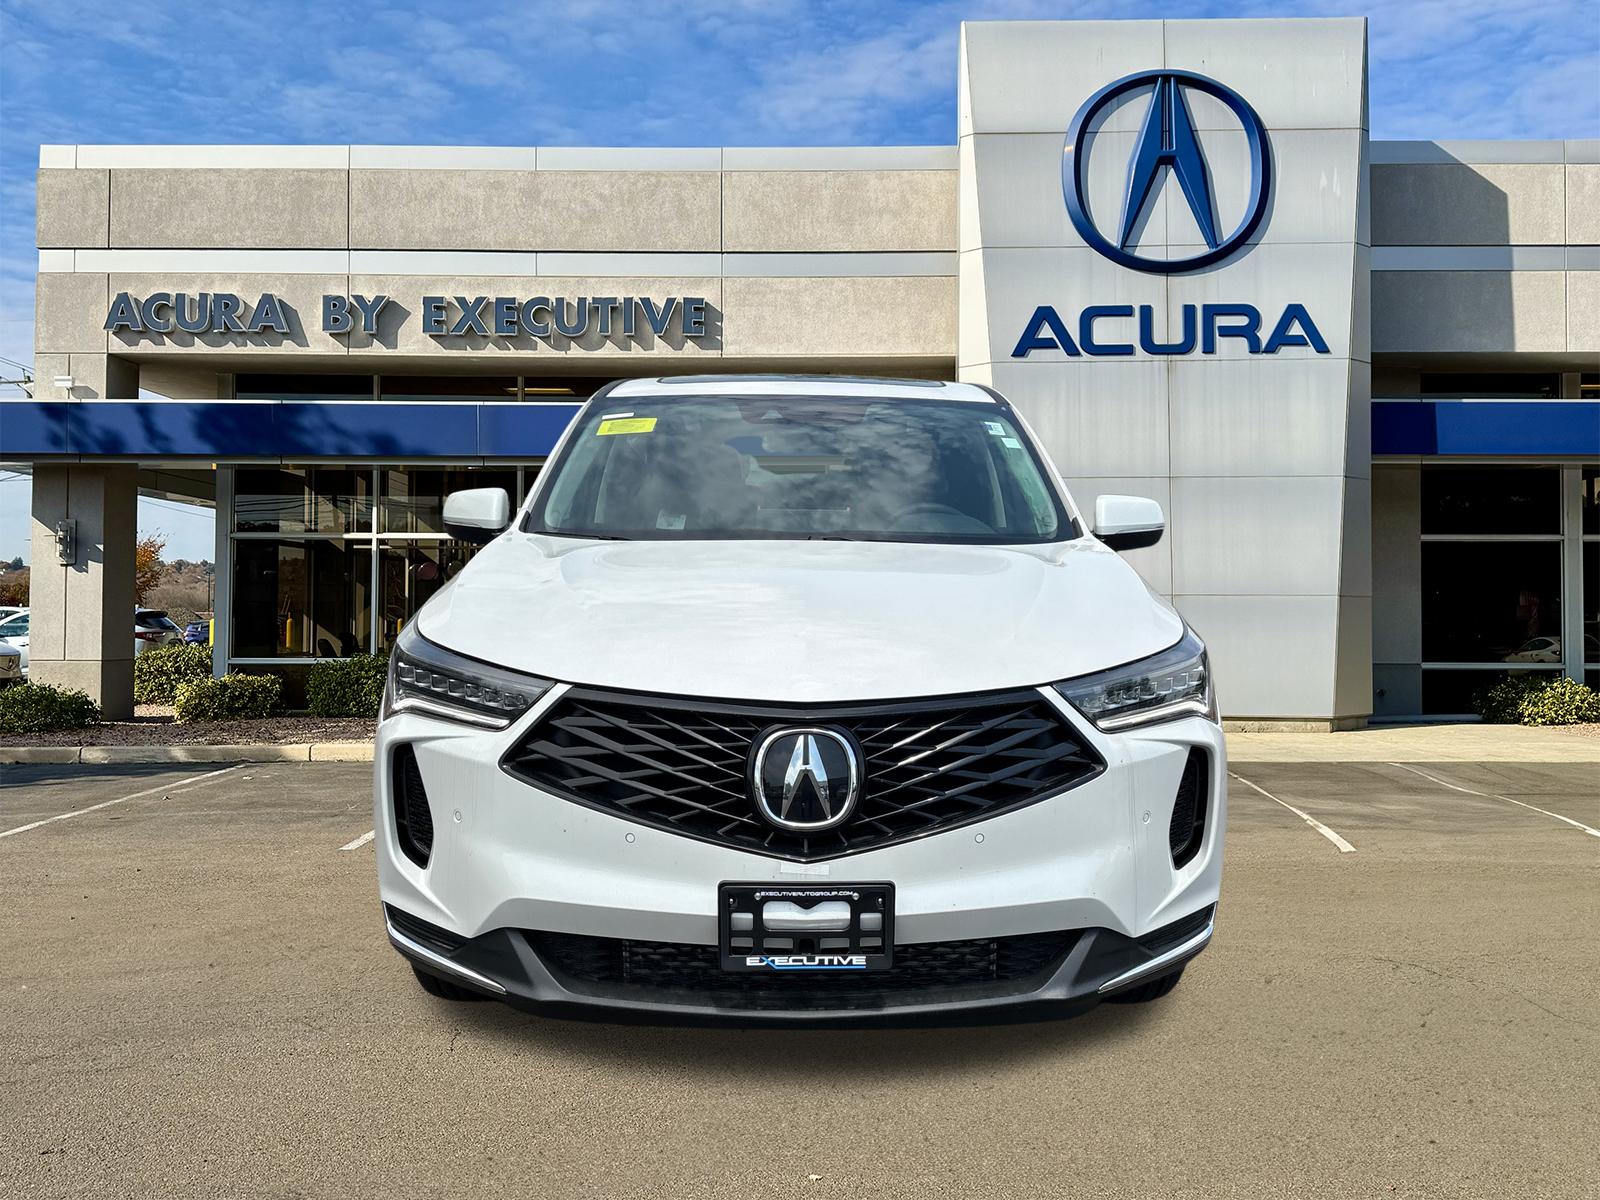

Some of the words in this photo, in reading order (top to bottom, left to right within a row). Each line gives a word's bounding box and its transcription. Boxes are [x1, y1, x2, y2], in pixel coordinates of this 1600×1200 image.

[104, 292, 290, 335] ACURA
[322, 294, 391, 335] BY
[421, 296, 707, 337] EXECUTIVE
[1011, 303, 1331, 357] ACURA
[746, 956, 867, 967] EXECUTIVE
